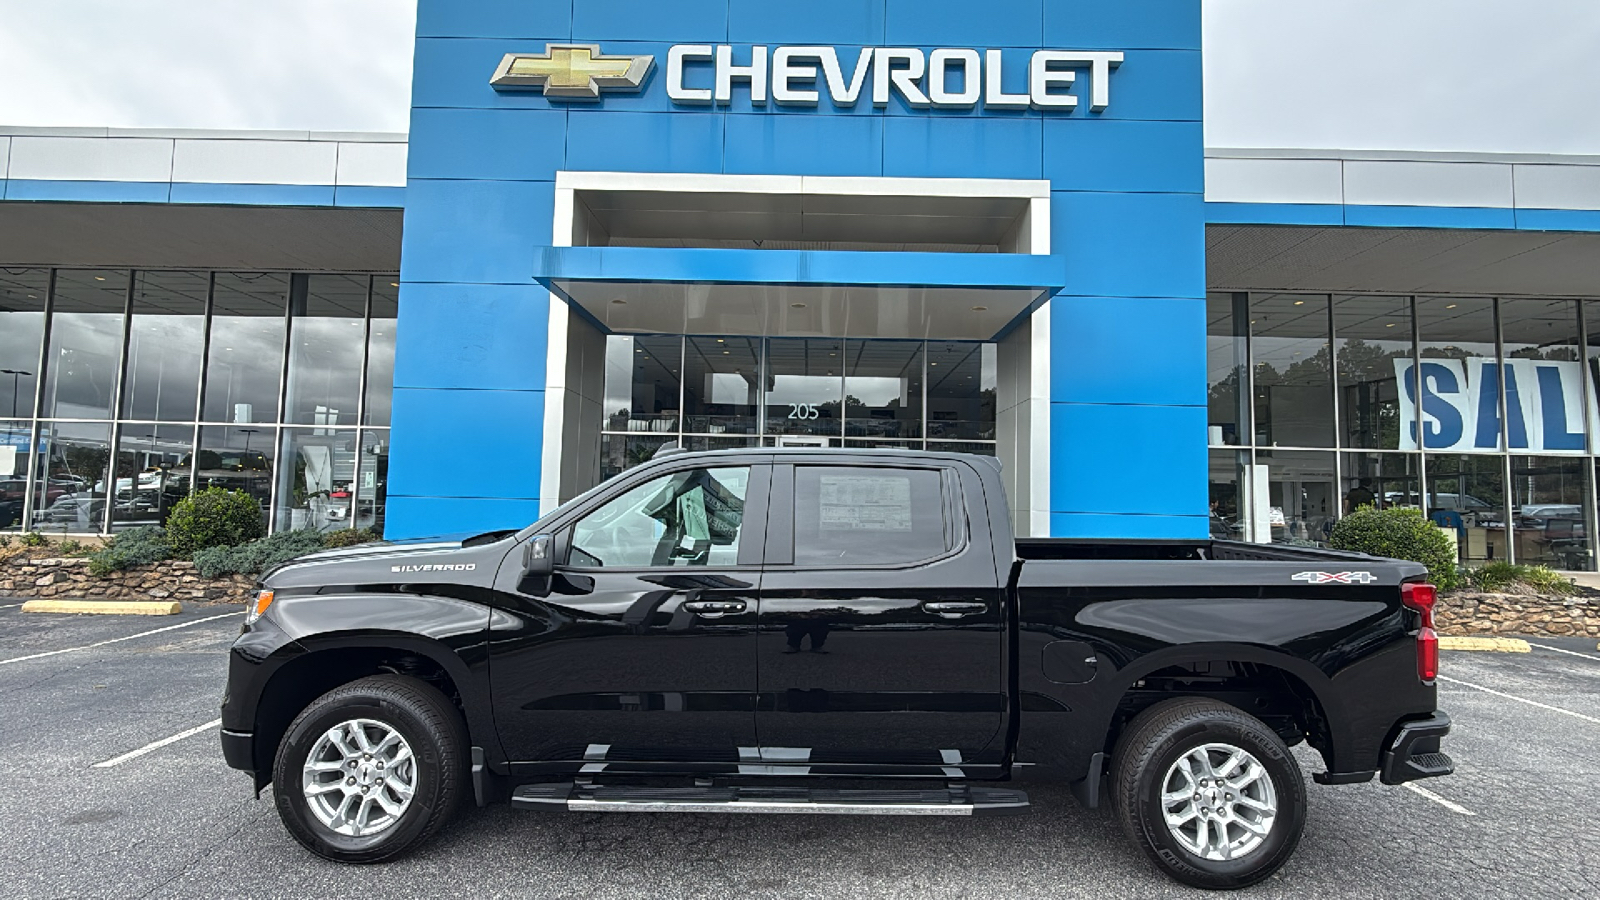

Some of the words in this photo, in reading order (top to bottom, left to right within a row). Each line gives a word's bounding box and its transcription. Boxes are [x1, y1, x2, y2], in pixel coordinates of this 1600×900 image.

[667, 44, 1124, 112] CHEVROLET
[788, 403, 819, 420] 205
[391, 563, 476, 573] SILVERADO
